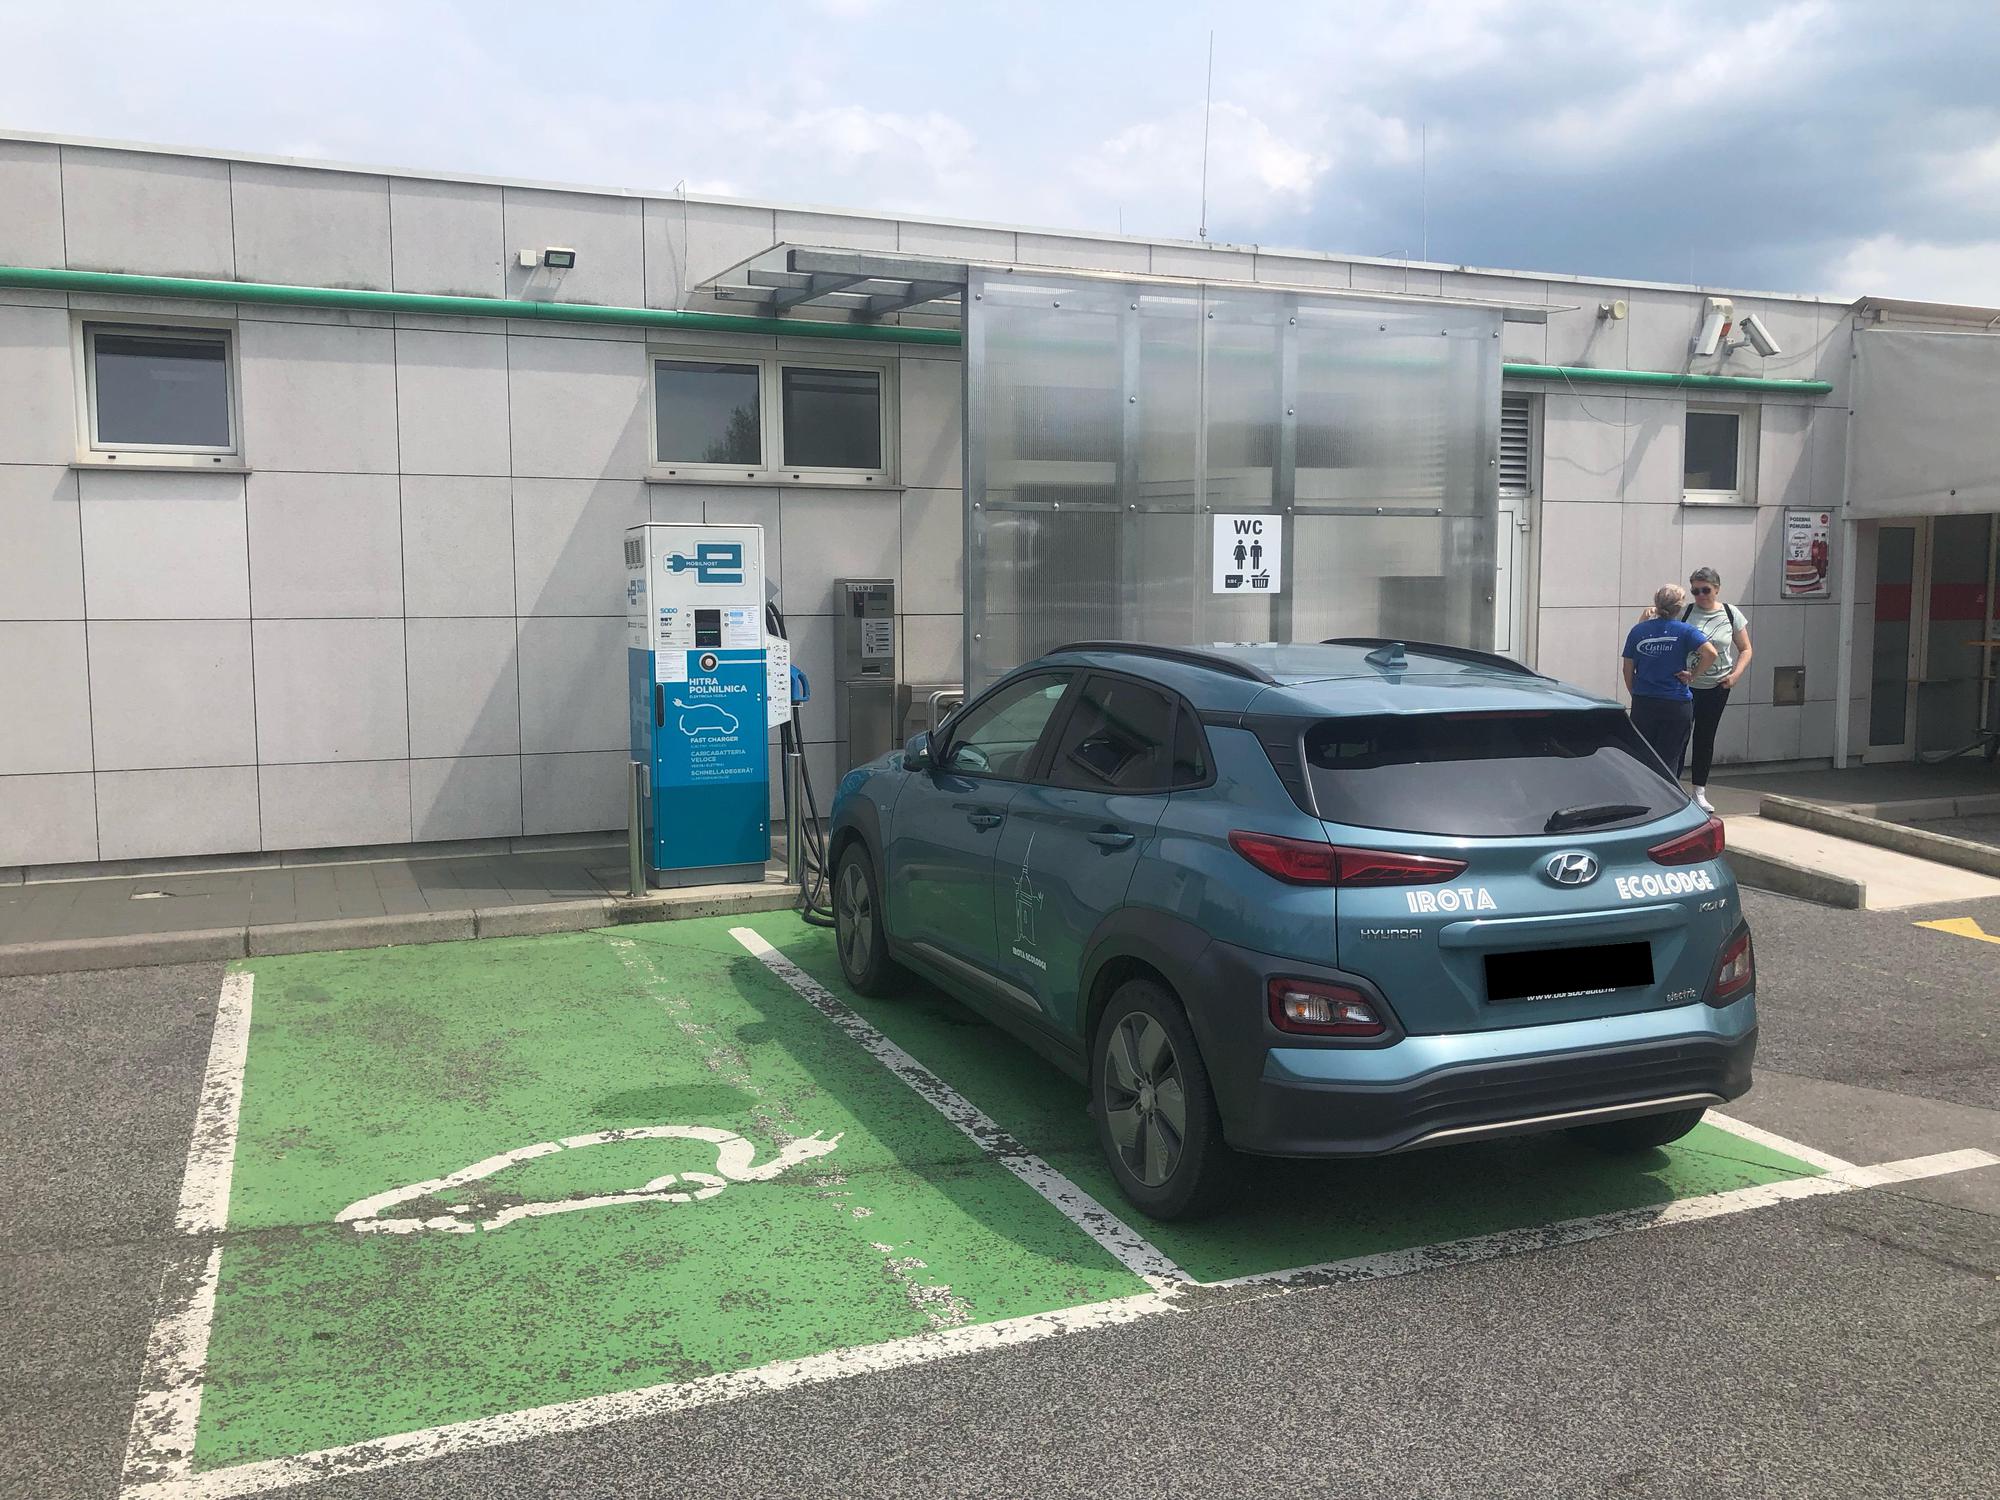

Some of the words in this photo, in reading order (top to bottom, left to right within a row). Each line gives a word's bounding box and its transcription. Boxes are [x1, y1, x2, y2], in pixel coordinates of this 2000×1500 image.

[1233, 519, 1263, 535] WC
[689, 677, 719, 686] HITRA
[689, 684, 748, 694] POLNILNICA
[1614, 869, 1715, 900] ECOLODGE
[1405, 887, 1498, 913] IROTA
[1360, 928, 1422, 940] HYUNDAI
[1666, 987, 1696, 1001] electric
